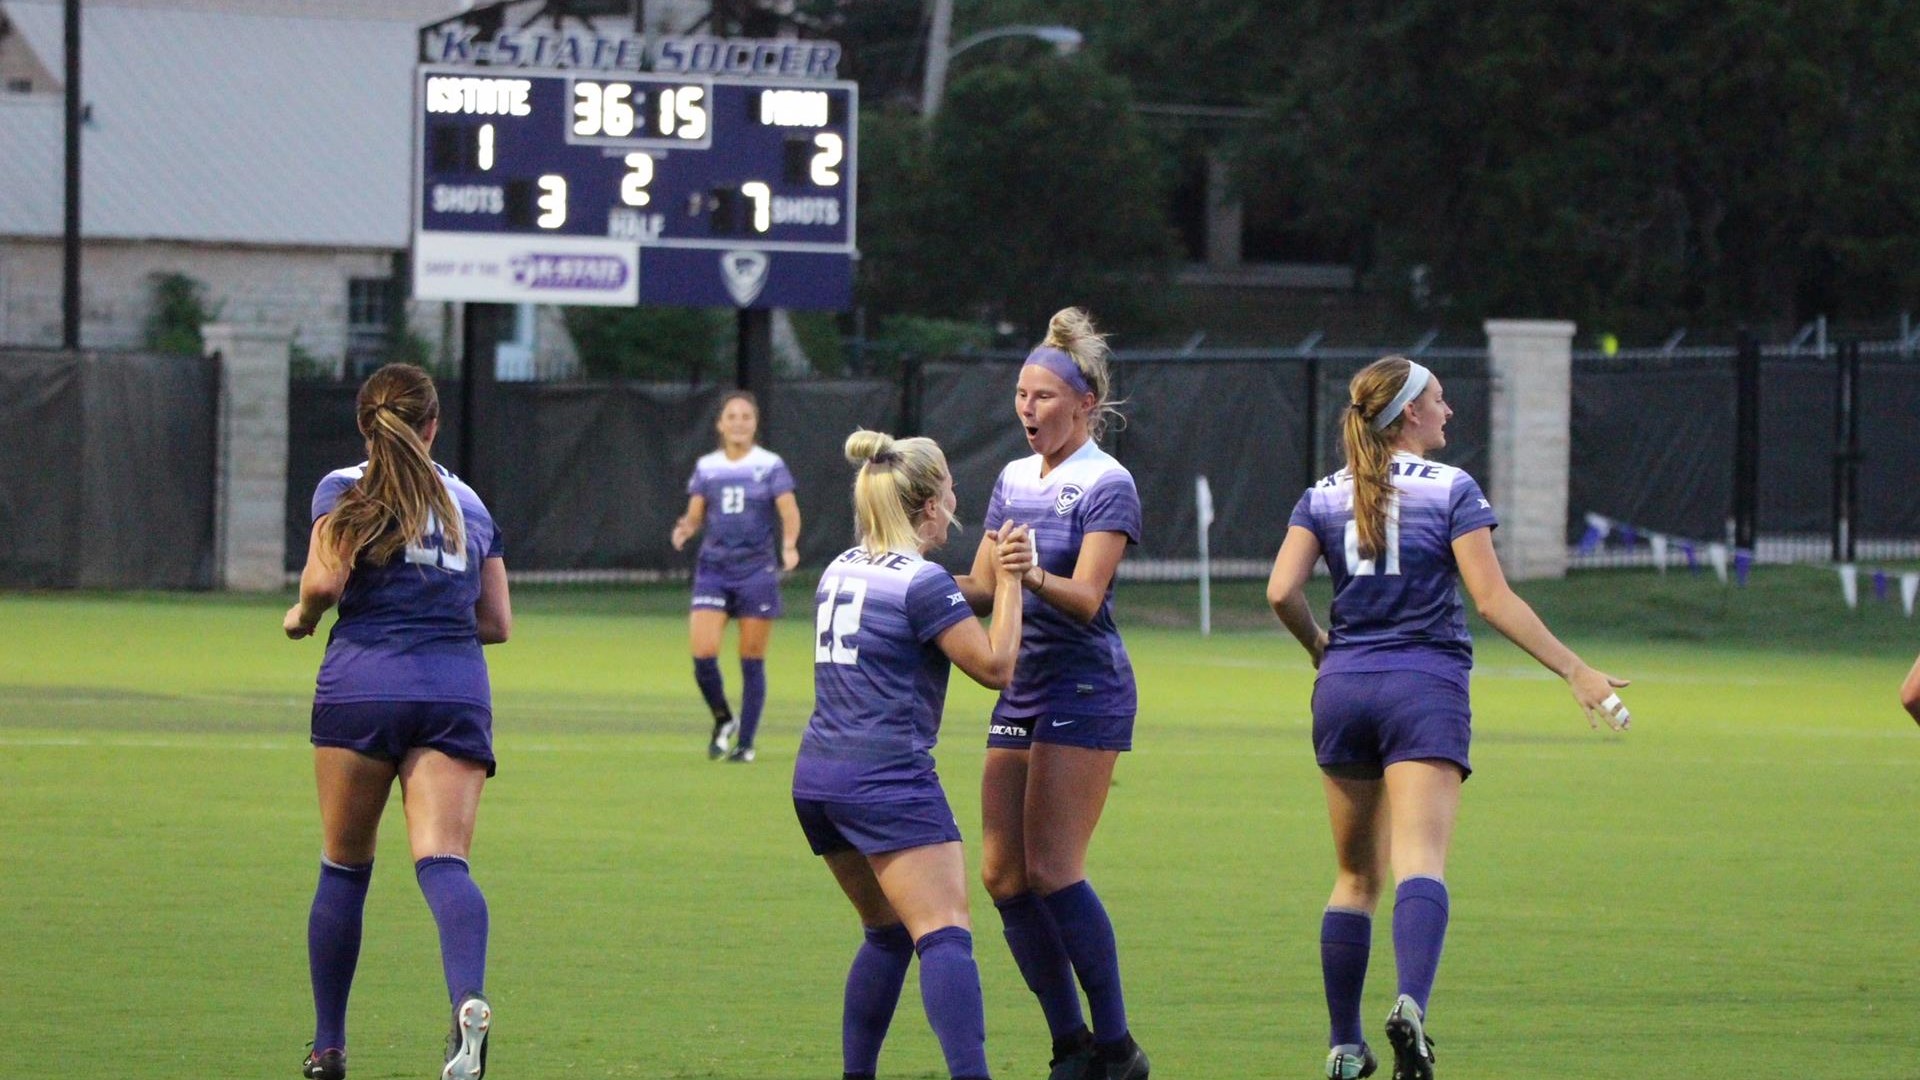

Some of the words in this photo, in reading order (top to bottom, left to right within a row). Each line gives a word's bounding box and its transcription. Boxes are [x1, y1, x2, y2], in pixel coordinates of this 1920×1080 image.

[438, 29, 642, 71] K-STATE
[656, 38, 842, 77] SOCCER
[478, 123, 494, 171] 1
[811, 132, 843, 187] 2
[432, 184, 504, 214] SHOTS
[537, 174, 567, 229] 3
[621, 152, 654, 206] 2
[608, 207, 665, 241] HALF
[741, 181, 770, 233] 7
[771, 195, 840, 225] SHOTS
[721, 485, 745, 515] 23
[814, 575, 868, 665] 22
